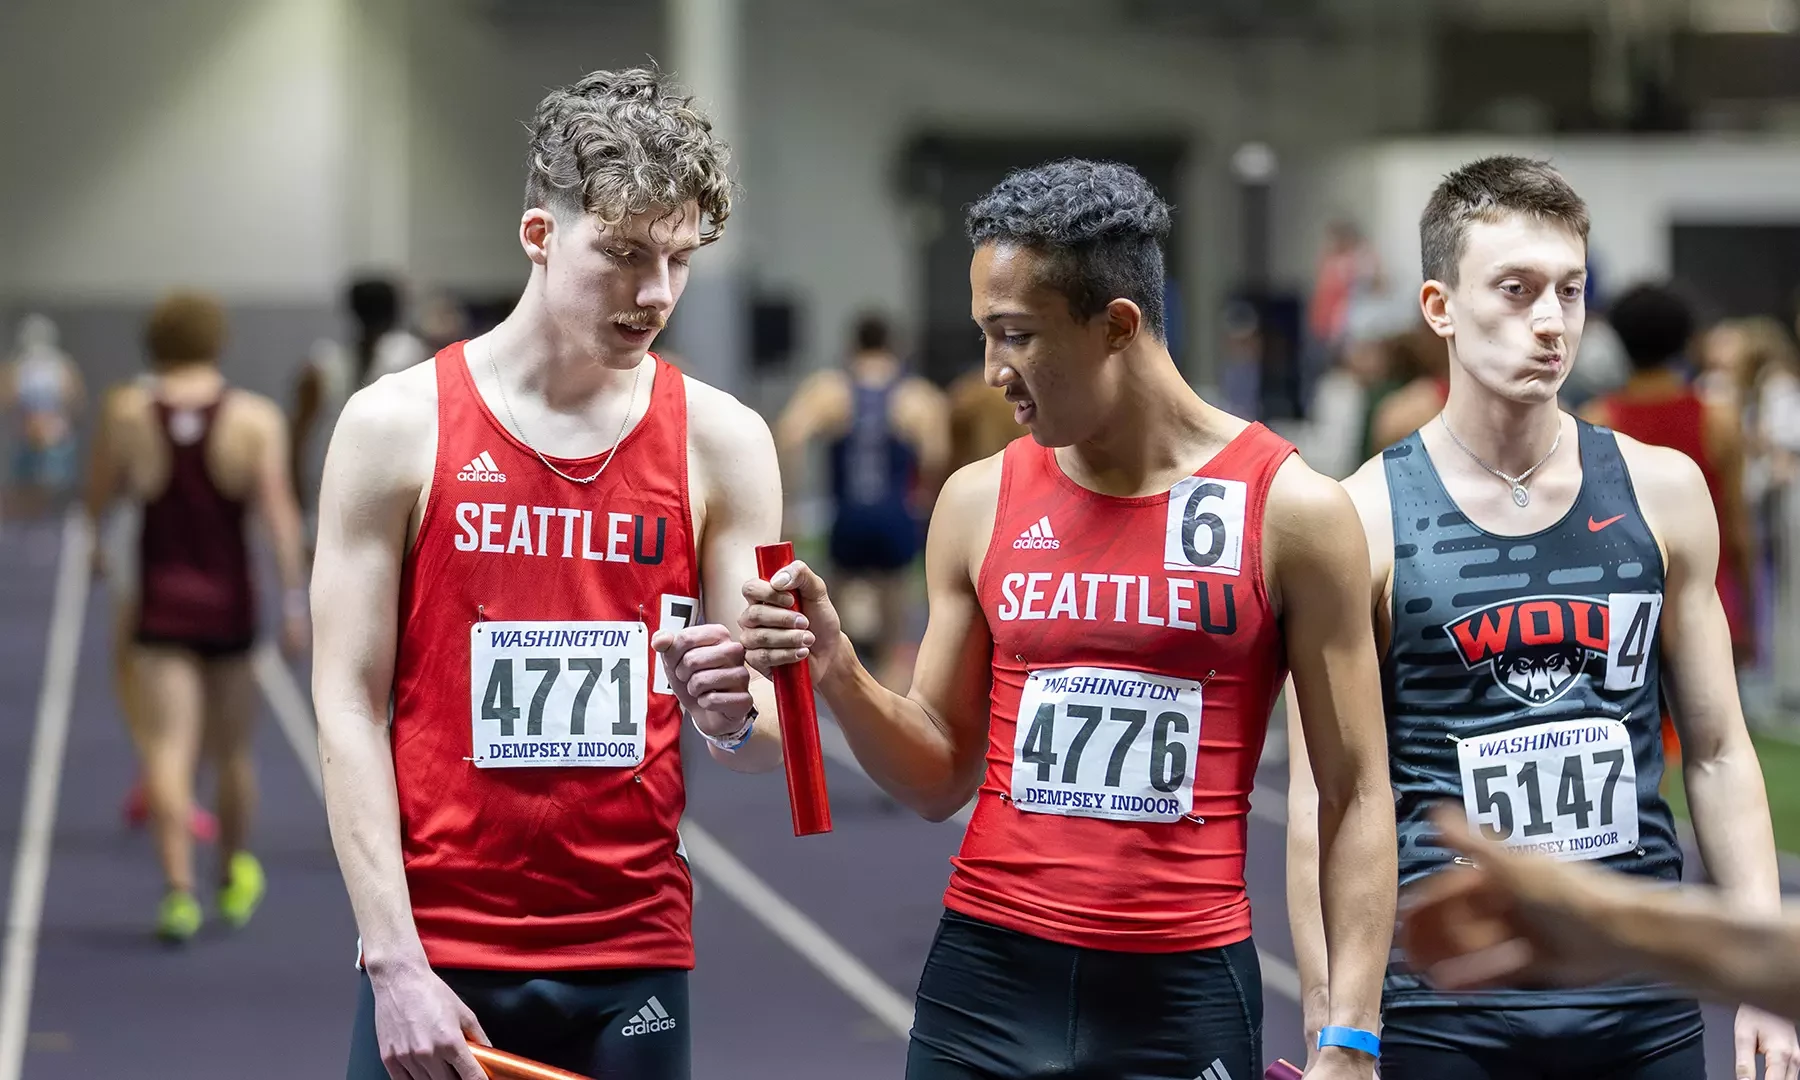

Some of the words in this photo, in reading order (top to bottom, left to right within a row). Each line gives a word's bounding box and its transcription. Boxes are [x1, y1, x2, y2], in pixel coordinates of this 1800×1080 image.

[457, 469, 507, 484] adidas
[1180, 482, 1227, 568] 6
[1012, 535, 1060, 550] adidas
[490, 630, 631, 648] WASHINGTON
[1452, 600, 1609, 663] WOU
[1616, 601, 1653, 683] 4
[481, 657, 640, 737] 4771
[1041, 676, 1182, 702] WASHINGTON
[489, 742, 572, 759] DEMPSEY
[577, 741, 636, 758] INDOOR
[1021, 702, 1190, 793] 4776
[1479, 725, 1609, 758] WASHINGTON
[1026, 787, 1106, 809] DEMPSEY
[1110, 794, 1180, 815] INDOOR
[1472, 748, 1626, 842] 5147
[1501, 840, 1564, 857] EMPSEY
[1569, 831, 1619, 851] INDOOR
[621, 1018, 676, 1036] adidas
